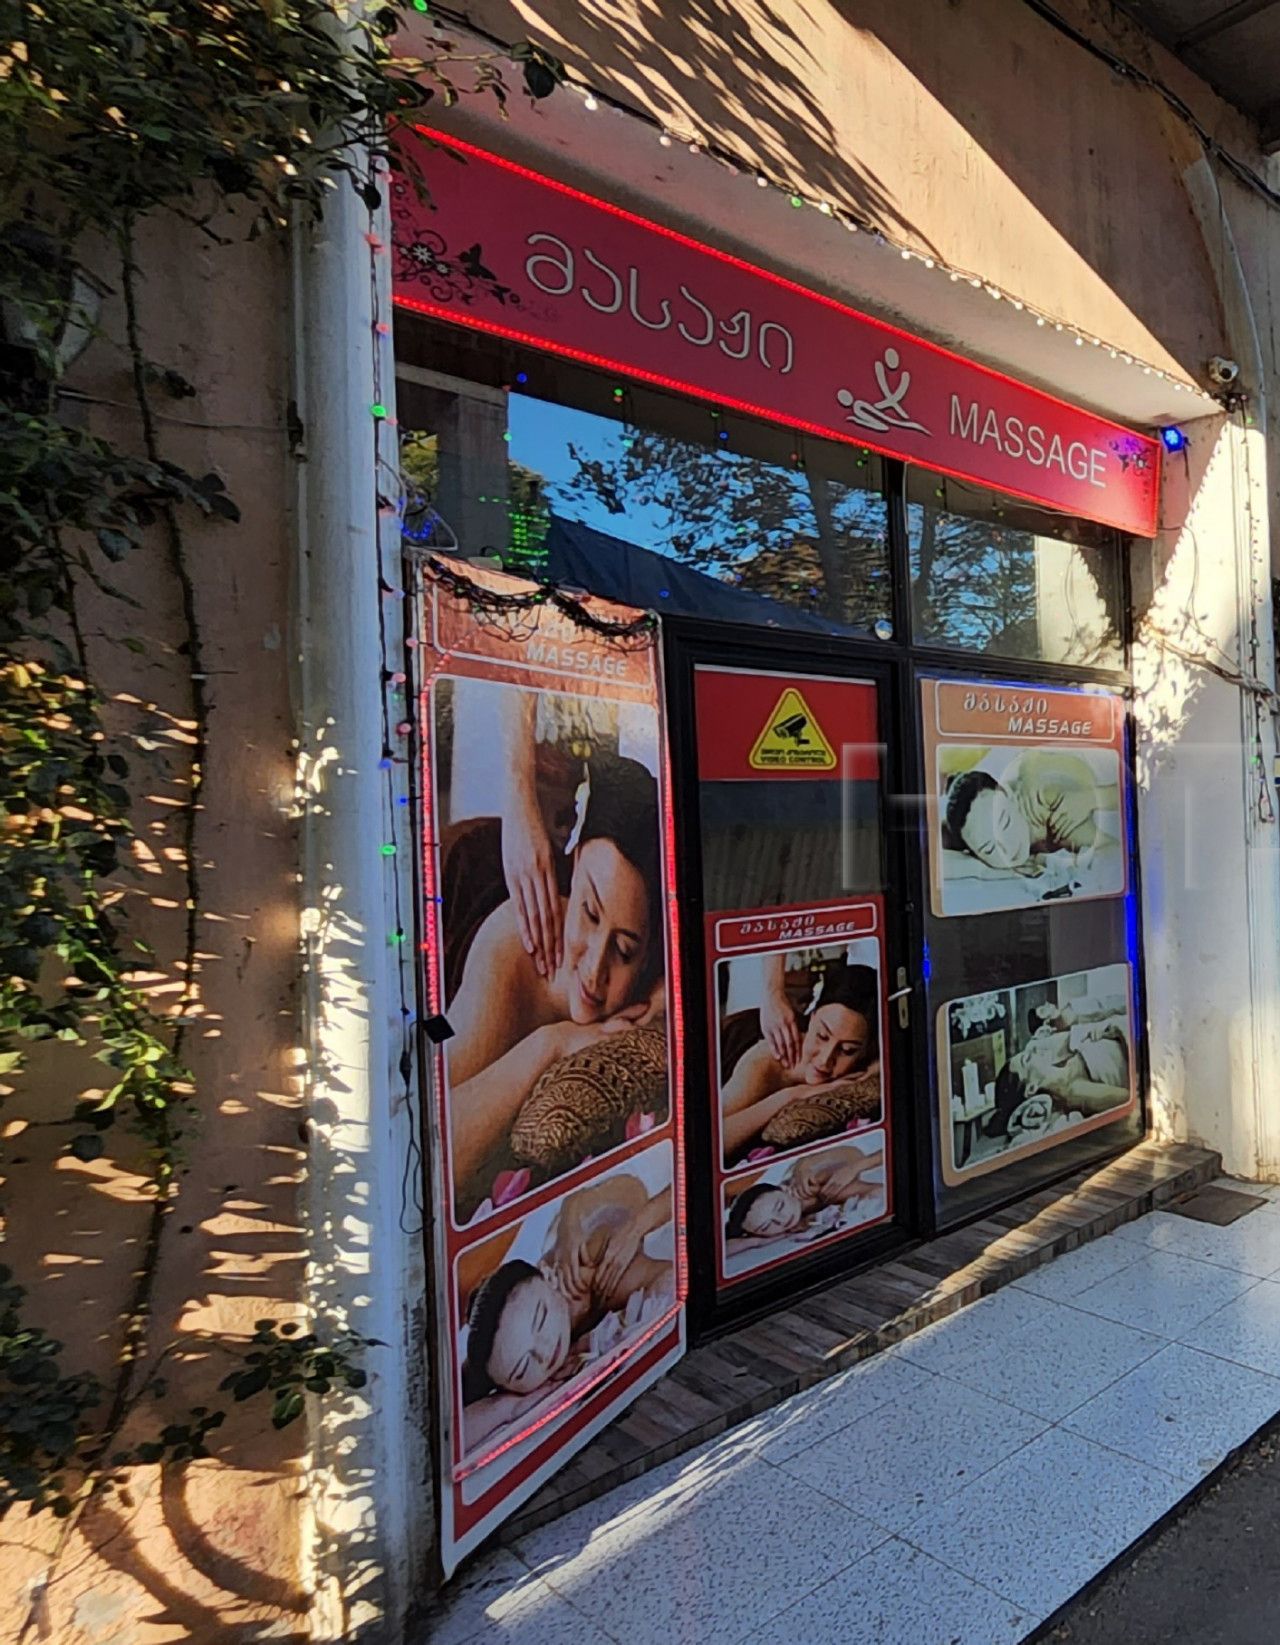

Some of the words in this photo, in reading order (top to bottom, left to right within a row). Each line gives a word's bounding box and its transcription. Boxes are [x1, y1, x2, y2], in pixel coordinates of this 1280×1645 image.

[524, 231, 794, 375] მასაჟი
[949, 394, 1108, 491] MASSAGE
[526, 642, 628, 677] MASSAGE
[964, 692, 1048, 715] მასაჟი
[1008, 717, 1093, 735] MASSAGE
[779, 921, 856, 940] MASSAGE
